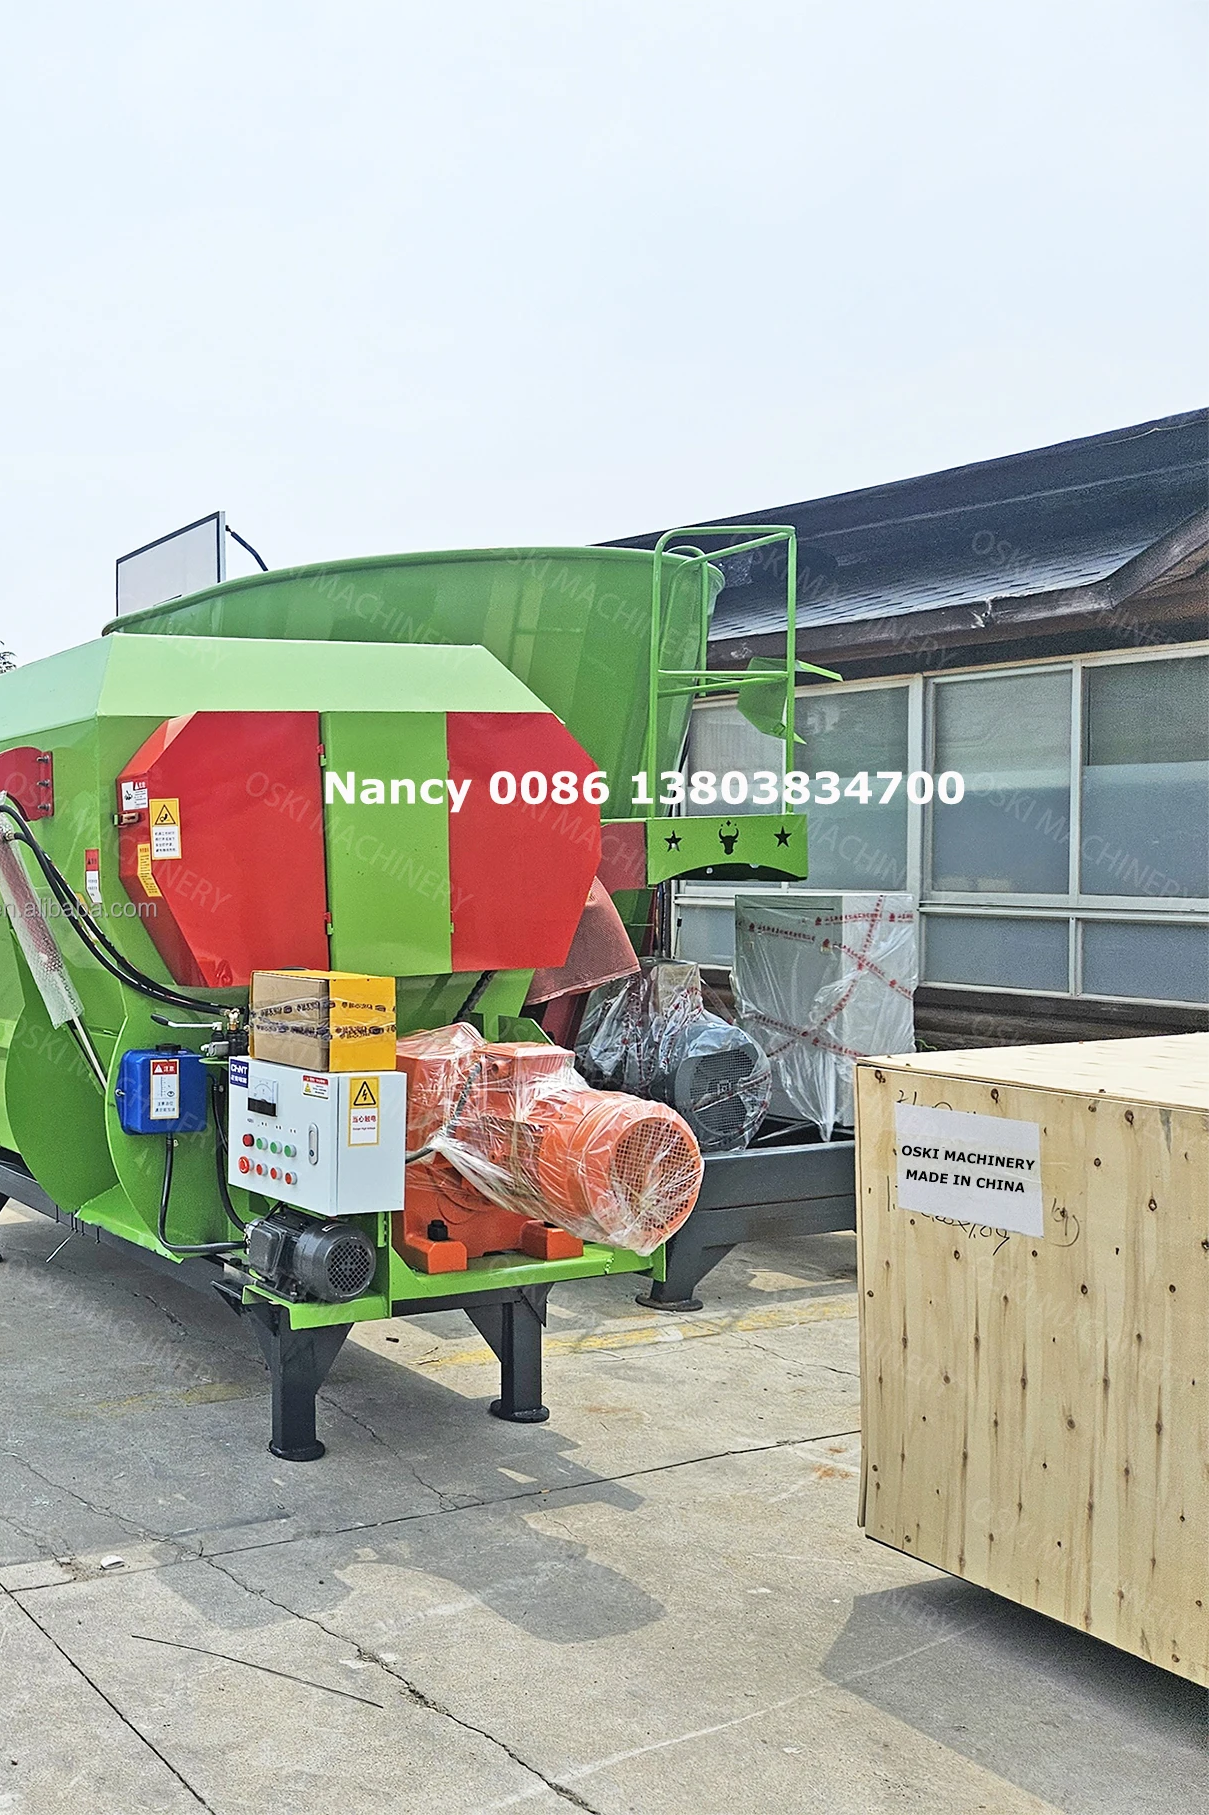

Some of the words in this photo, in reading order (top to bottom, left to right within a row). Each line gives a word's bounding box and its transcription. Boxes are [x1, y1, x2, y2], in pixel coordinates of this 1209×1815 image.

[901, 1145, 939, 1160] OSKI
[944, 1150, 1036, 1171] MACHINERY
[906, 1169, 948, 1184] MADE
[953, 1174, 971, 1187] IN
[976, 1177, 1025, 1193] CHINA
